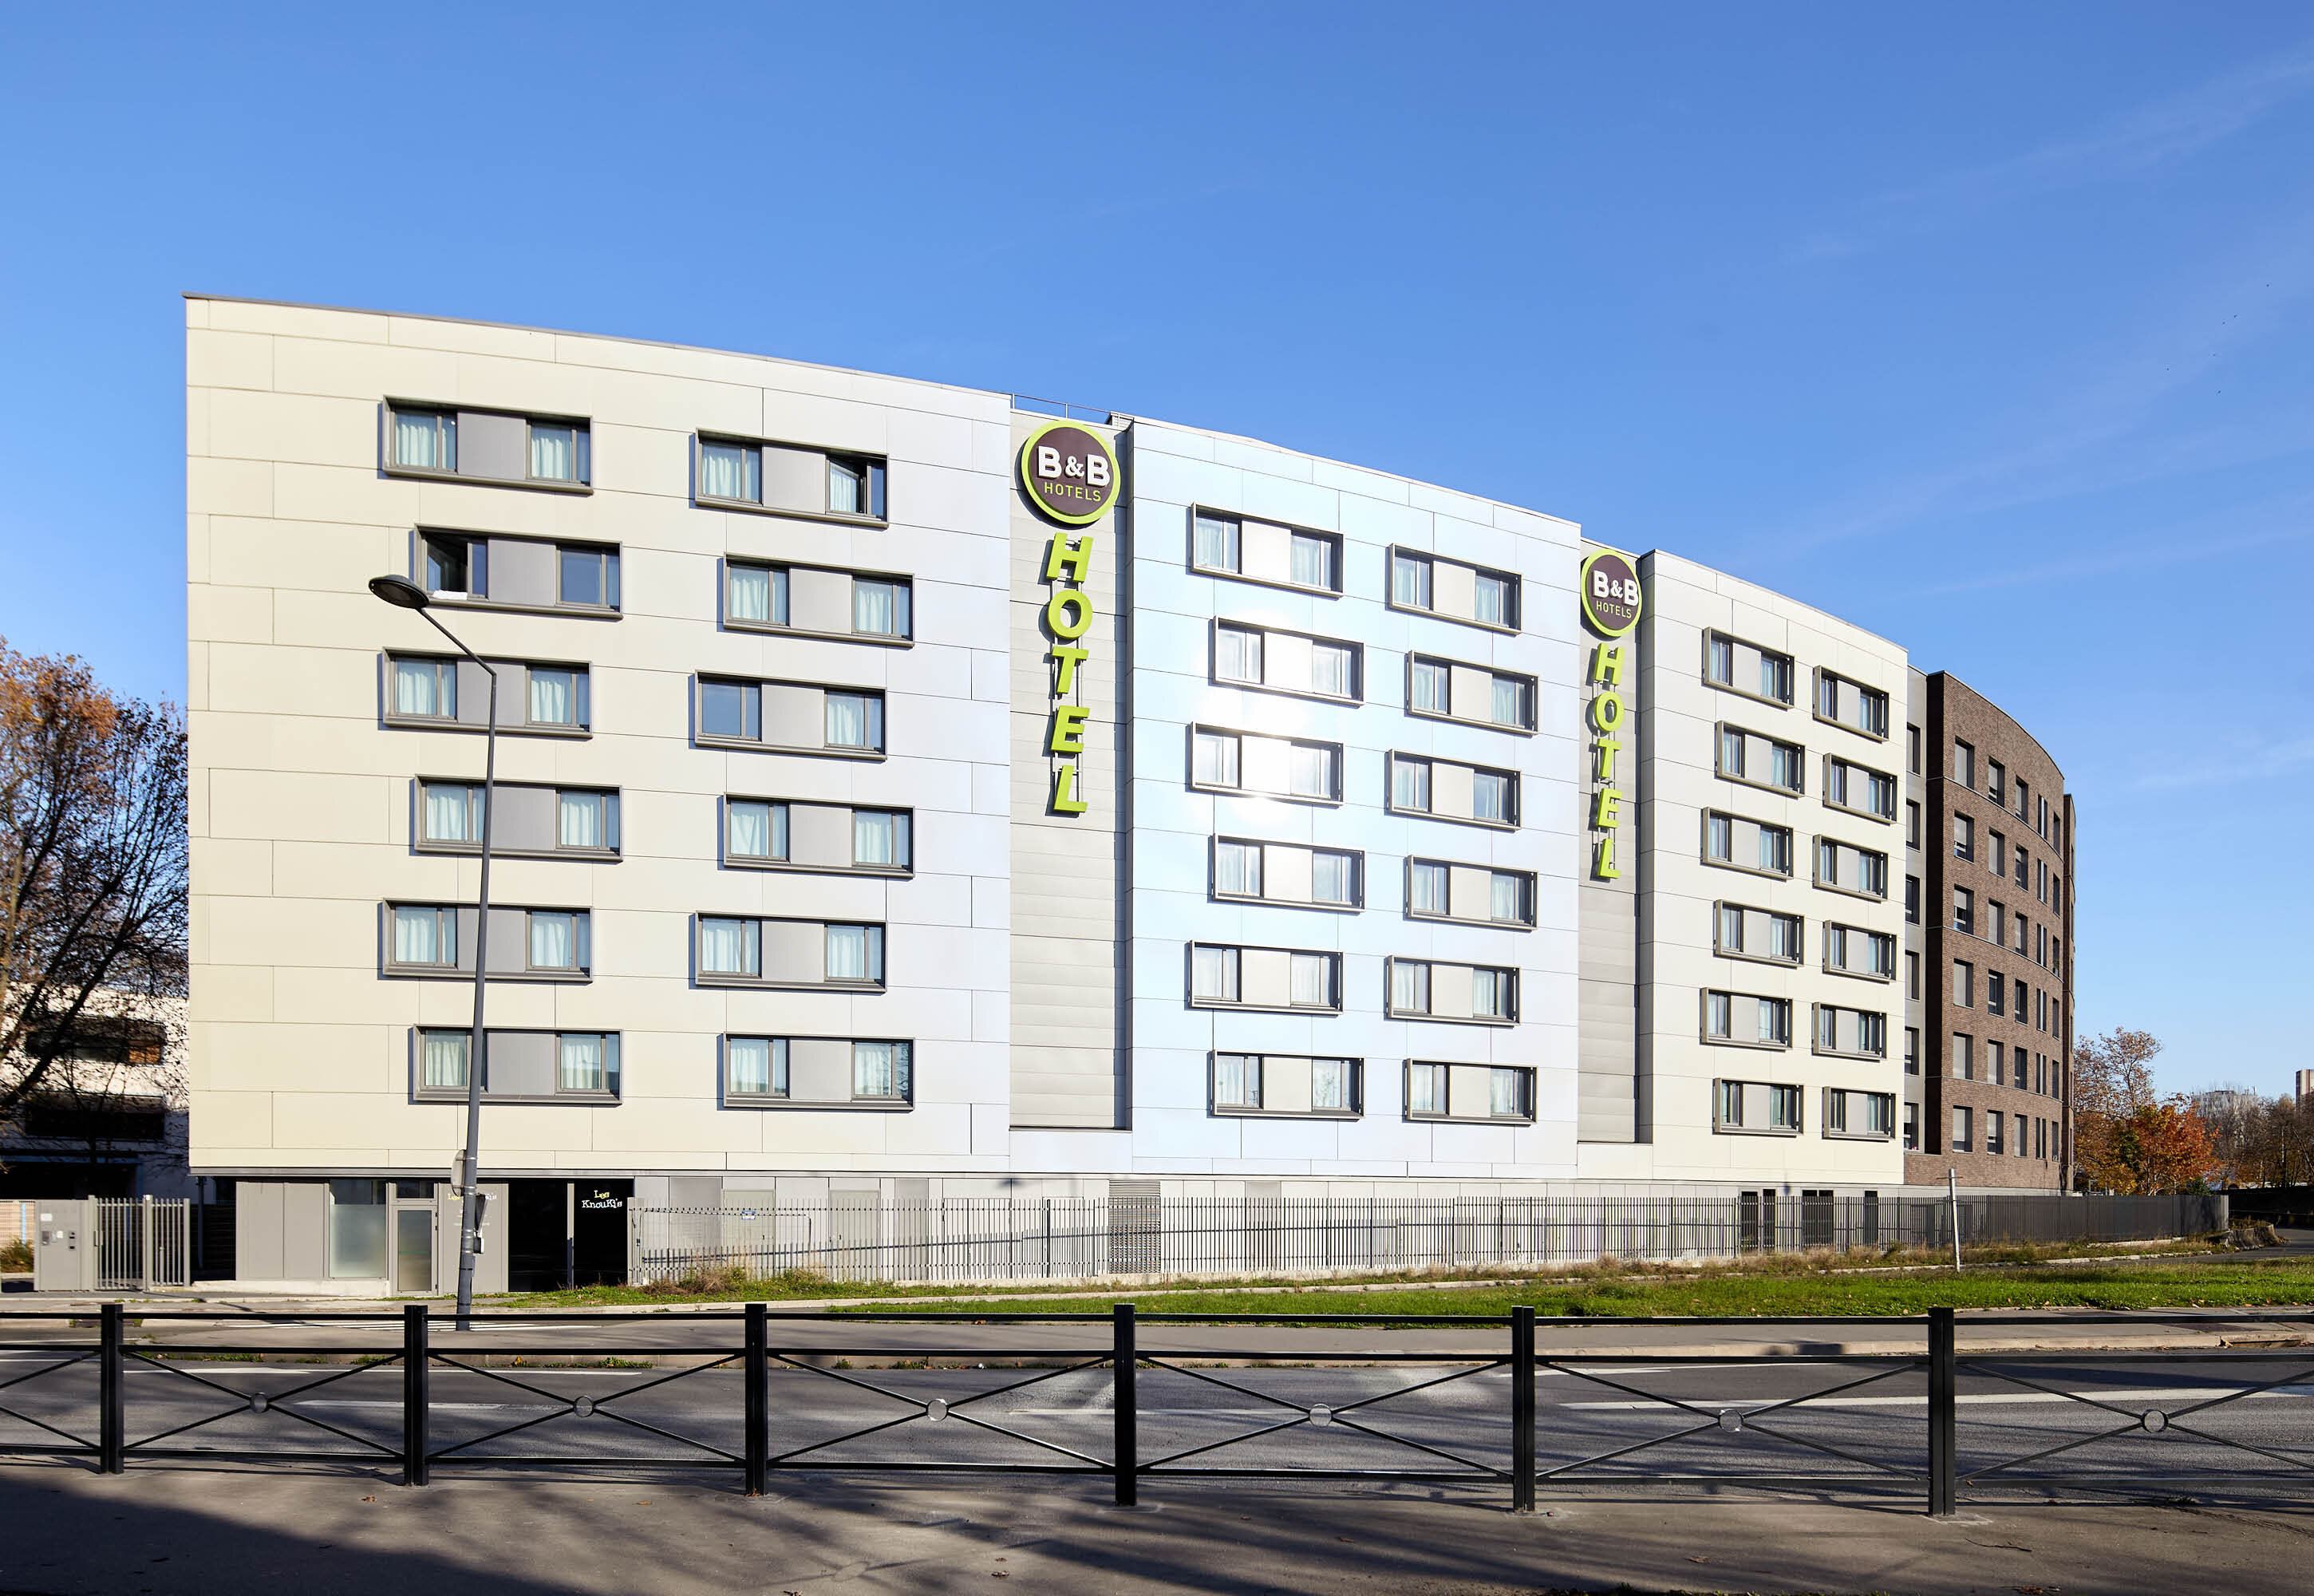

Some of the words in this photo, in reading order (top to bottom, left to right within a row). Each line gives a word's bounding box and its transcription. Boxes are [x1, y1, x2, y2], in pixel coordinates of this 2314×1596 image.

[1038, 445, 1111, 488] B&B
[1044, 481, 1102, 502] HOTELS
[1593, 570, 1639, 606] B&B
[1596, 599, 1633, 619] HOTELS
[1046, 532, 1094, 814] HOTEL
[1593, 642, 1625, 879] HOTEL
[593, 1190, 610, 1199] Les
